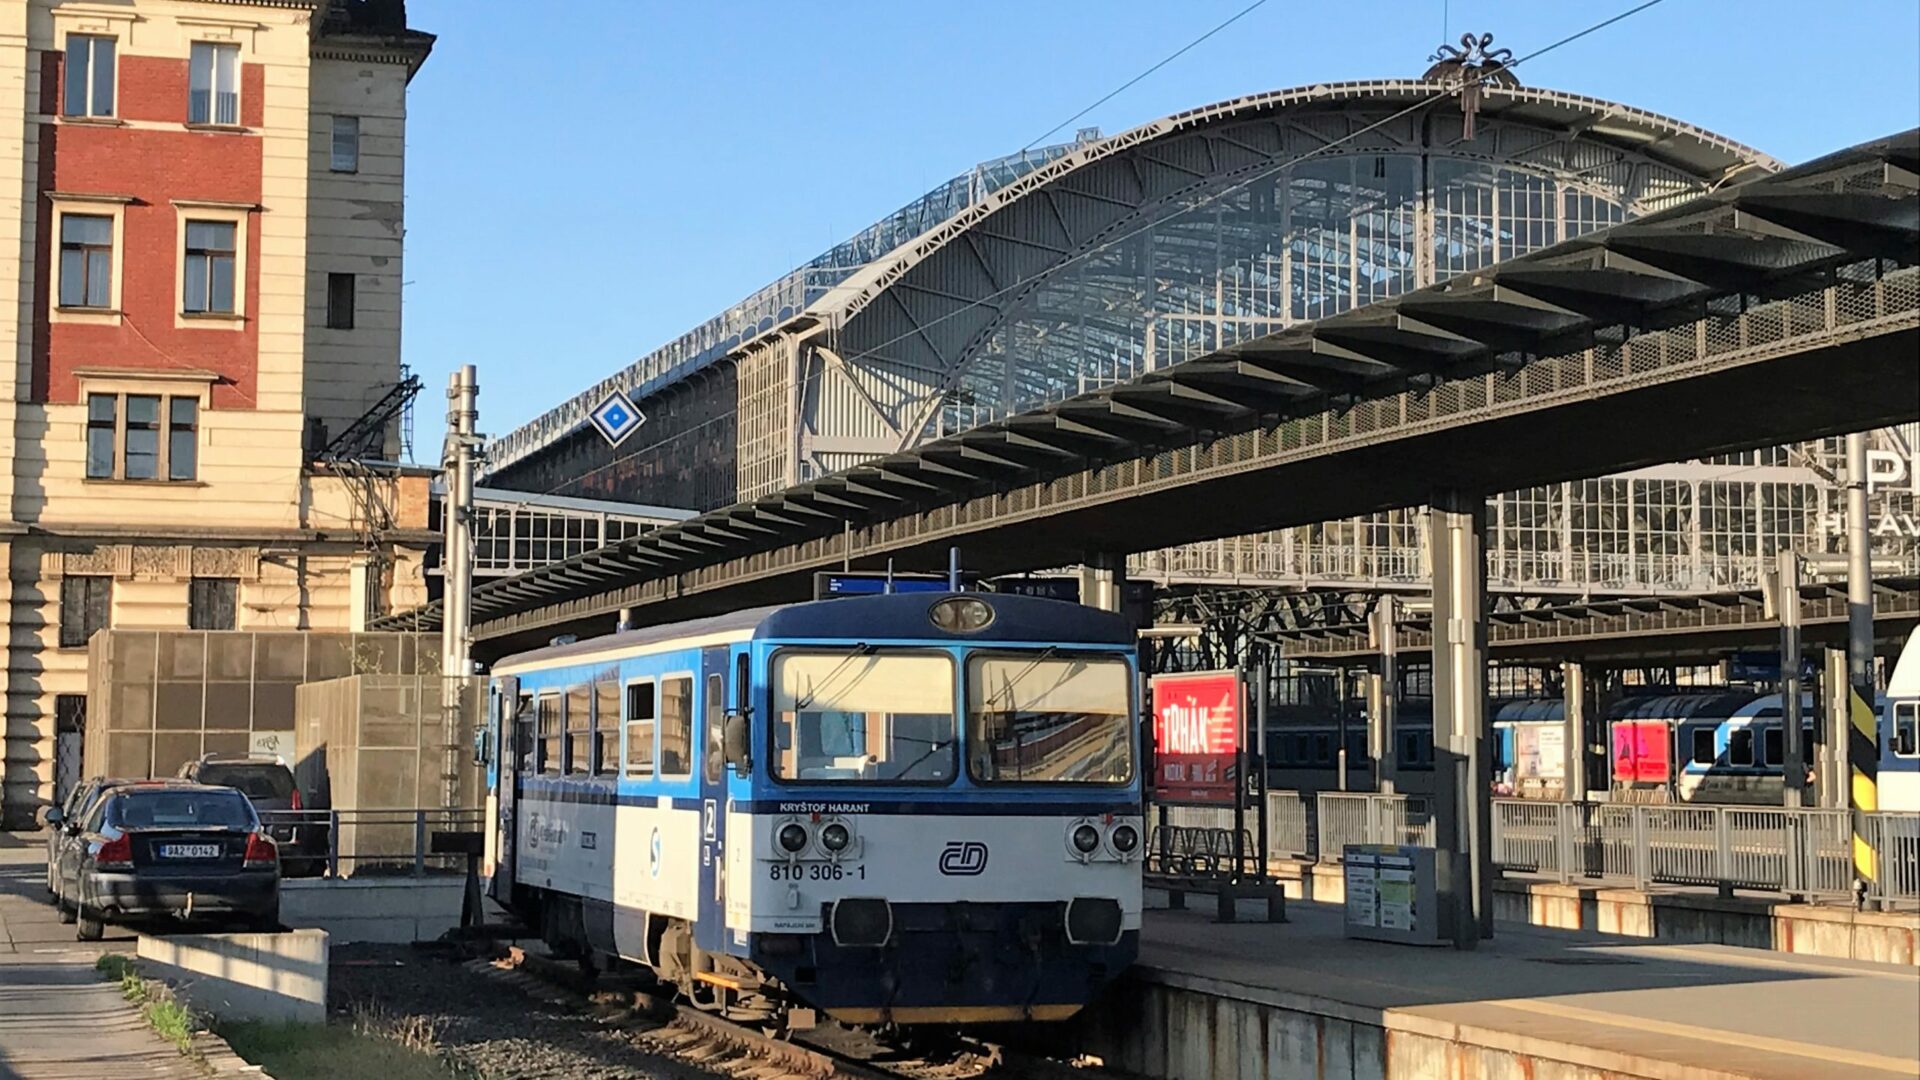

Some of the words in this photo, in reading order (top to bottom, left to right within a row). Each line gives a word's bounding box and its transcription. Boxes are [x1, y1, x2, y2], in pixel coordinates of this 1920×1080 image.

[1866, 450, 1920, 495] P
[1817, 512, 1920, 537] HAV
[706, 806, 714, 834] 2
[780, 802, 826, 812] KRYŠTOF
[828, 804, 870, 813] HARANT
[770, 865, 803, 880] 810
